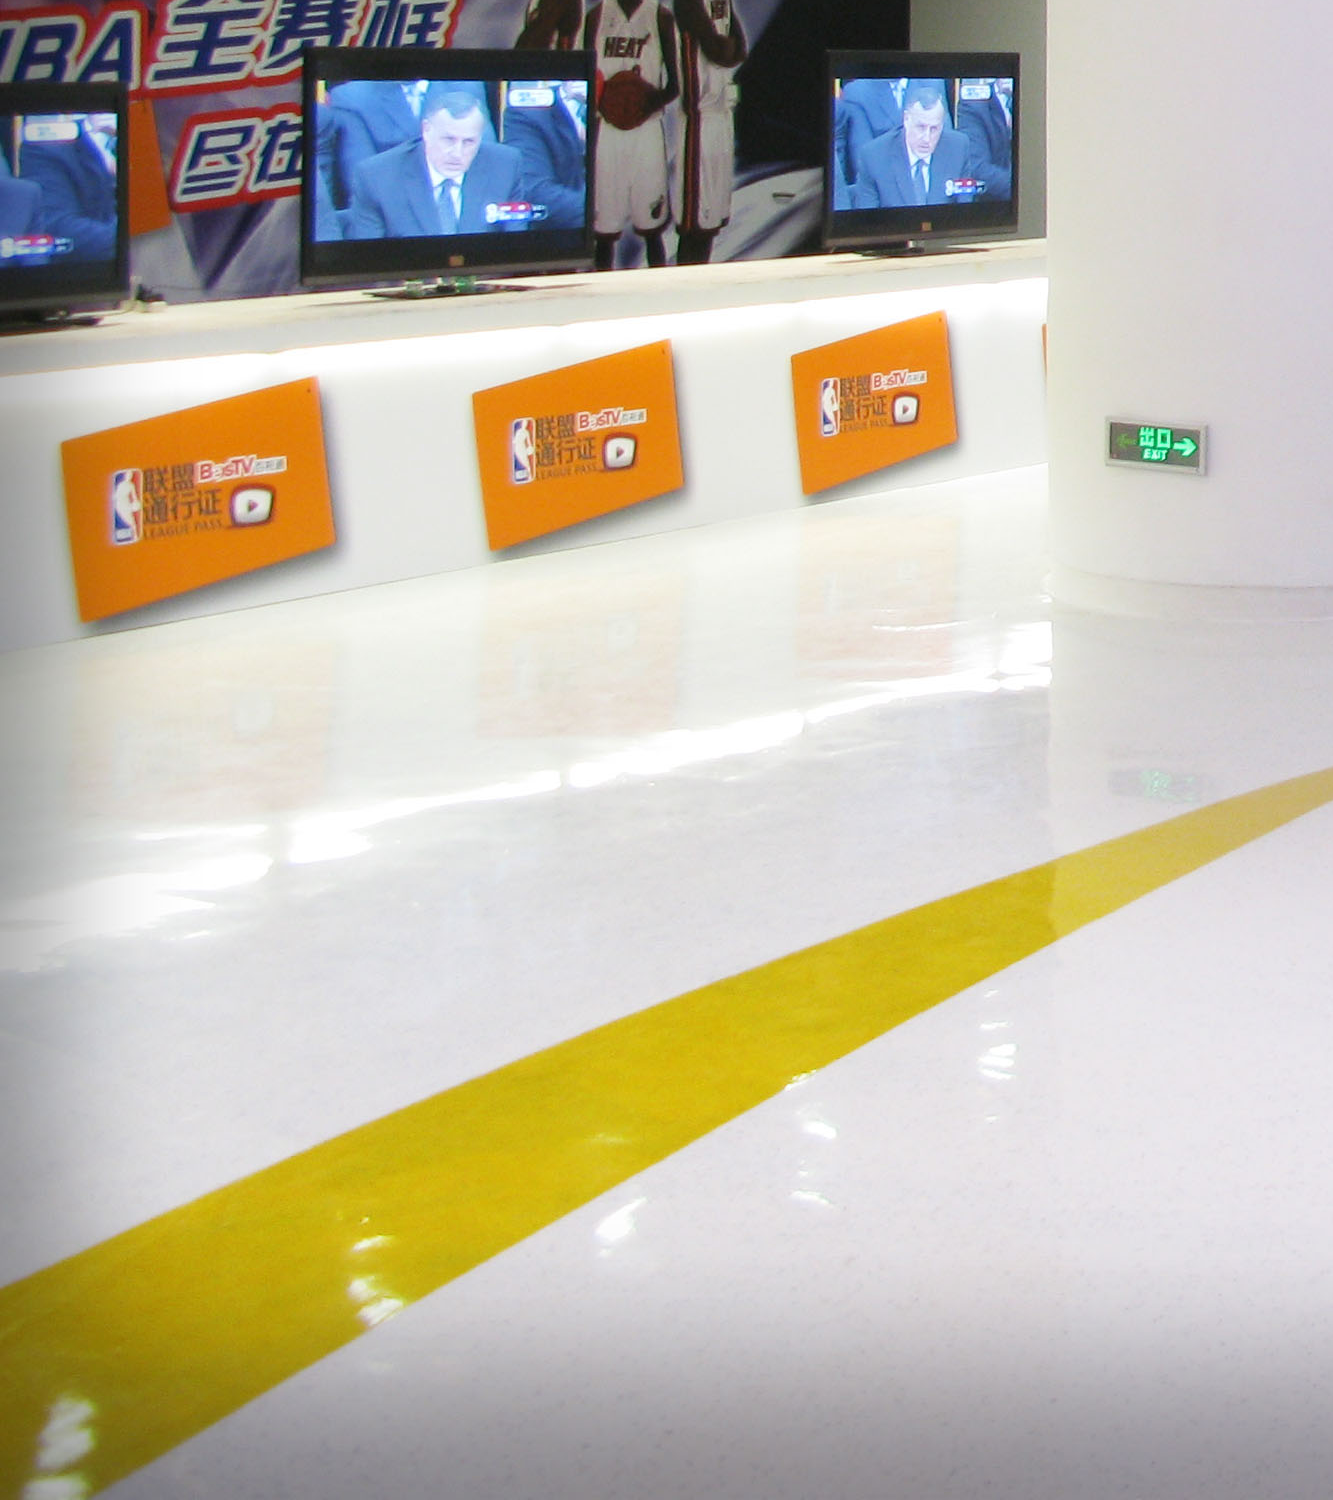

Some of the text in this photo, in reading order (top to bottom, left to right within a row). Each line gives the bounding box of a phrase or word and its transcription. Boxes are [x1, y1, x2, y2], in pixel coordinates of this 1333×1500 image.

[604, 33, 651, 59] HEAT
[1138, 426, 1172, 449] 出口
[1142, 448, 1169, 462] EXIT
